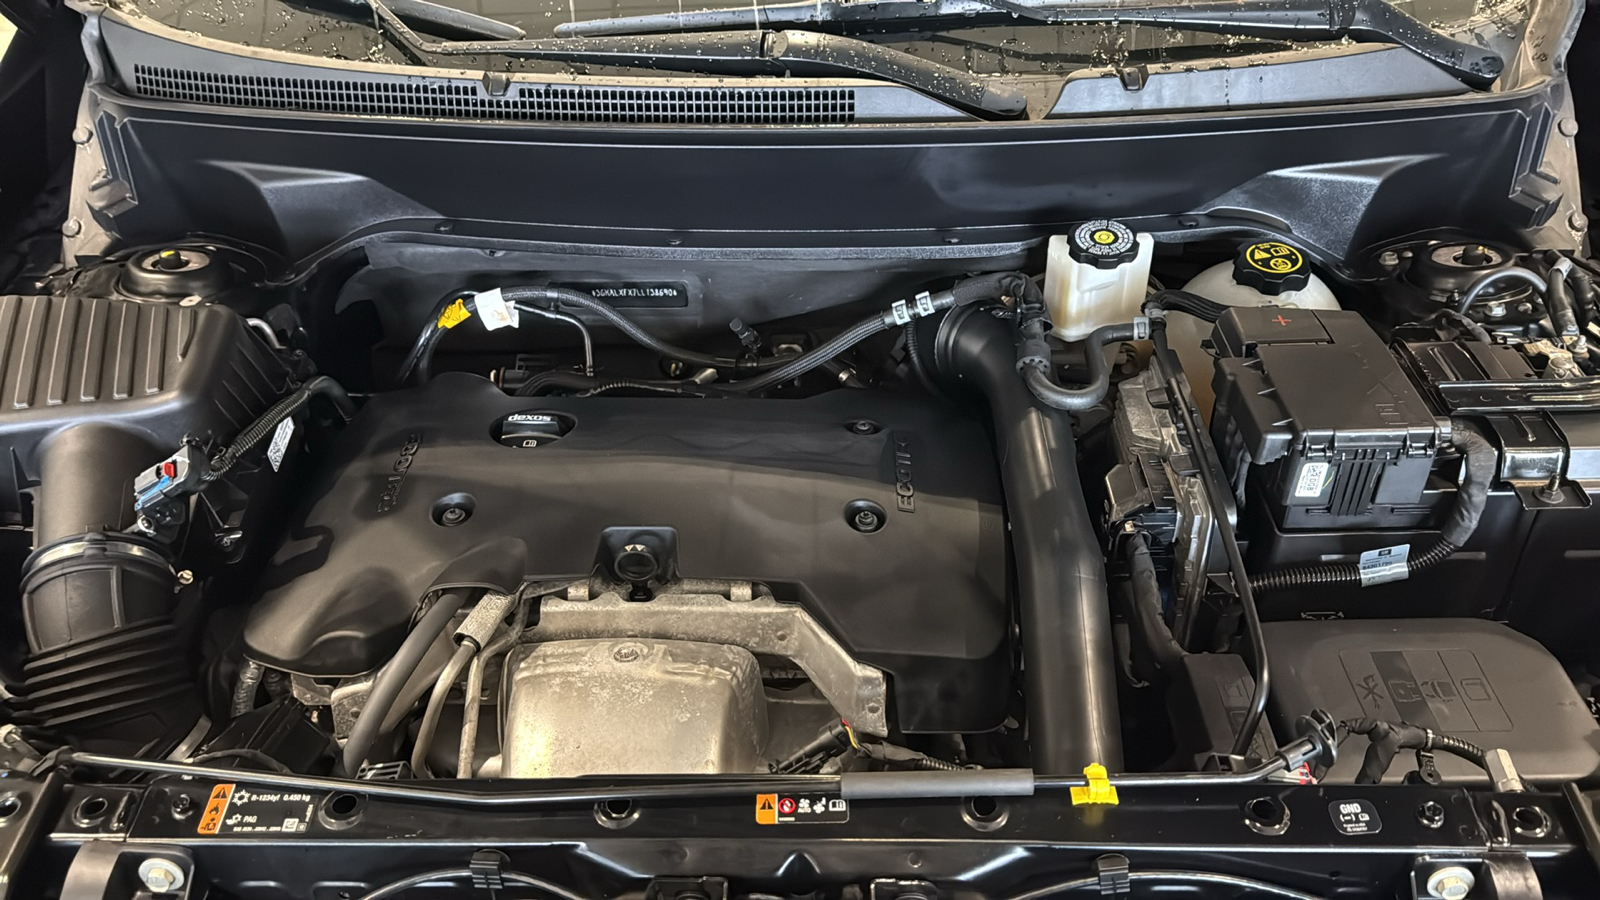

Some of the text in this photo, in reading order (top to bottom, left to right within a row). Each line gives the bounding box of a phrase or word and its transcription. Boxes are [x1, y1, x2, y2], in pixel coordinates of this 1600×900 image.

[508, 414, 553, 422] dexos
[302, 793, 312, 802] kg
[1339, 803, 1362, 814] GND
[242, 815, 258, 823] PAG
